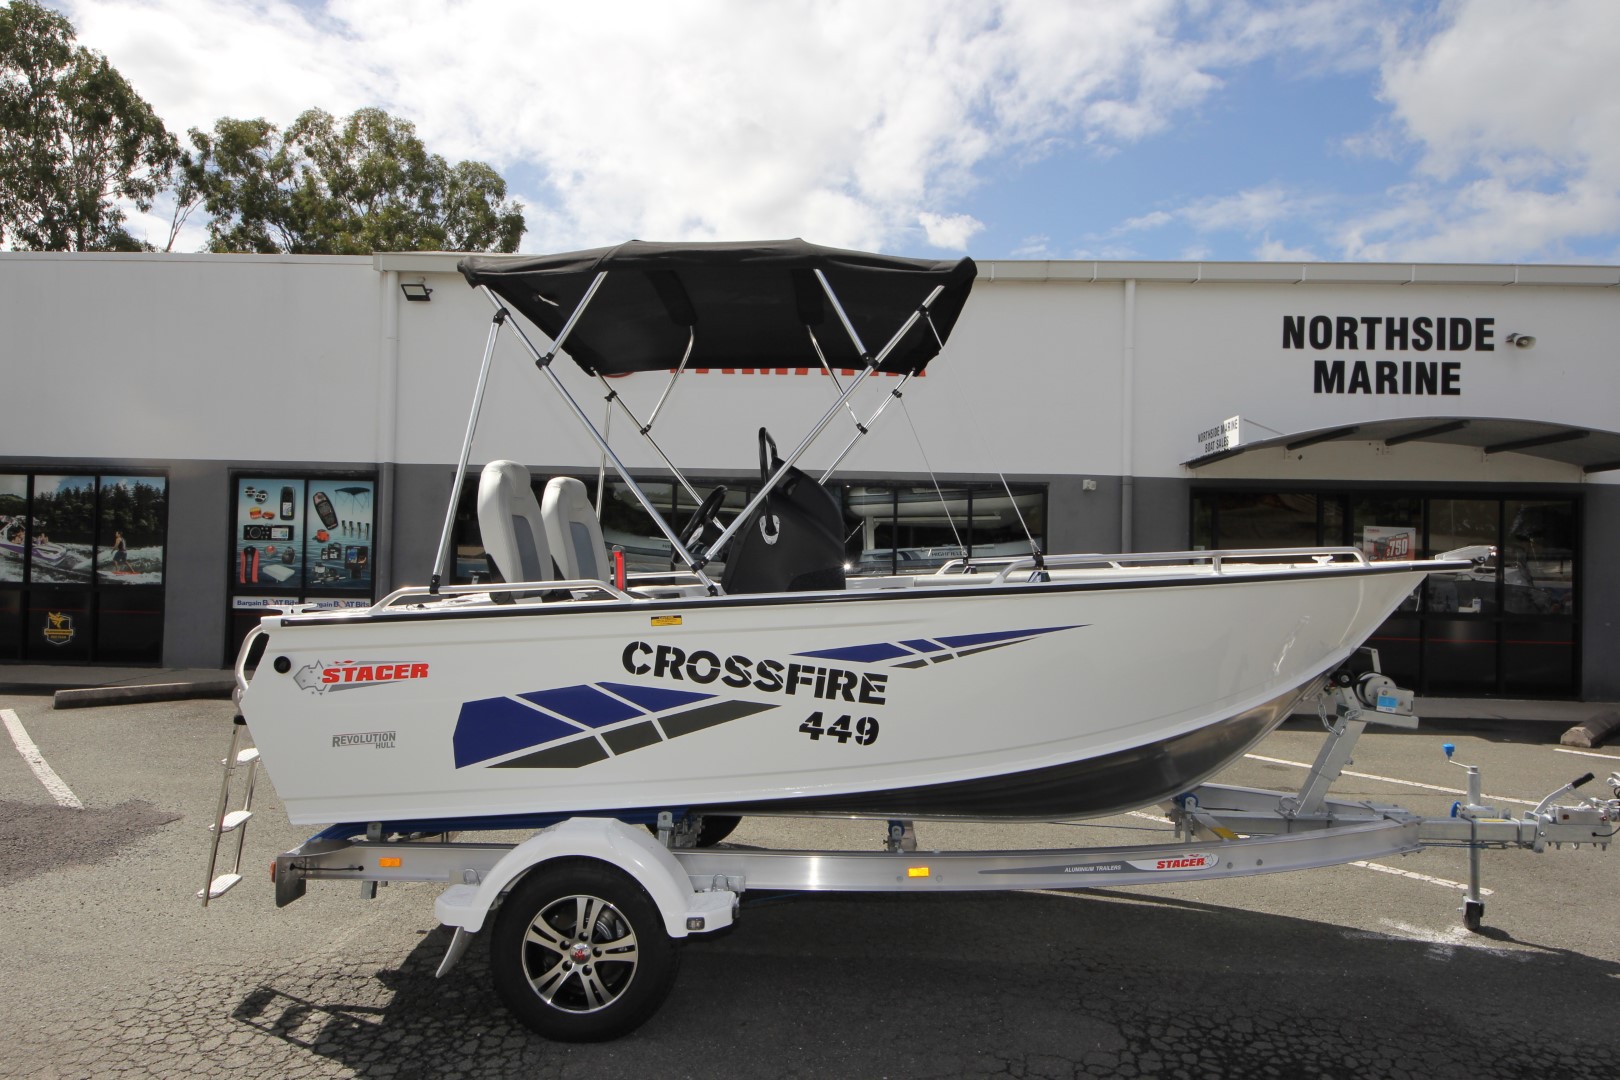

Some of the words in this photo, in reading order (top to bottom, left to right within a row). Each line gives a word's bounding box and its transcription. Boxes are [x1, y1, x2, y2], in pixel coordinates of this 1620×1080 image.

[1282, 315, 1495, 351] NORTHSIDE
[1313, 360, 1461, 395] MARINE
[1197, 425, 1220, 443] NORTHSIDE
[1220, 418, 1238, 435] MARINE
[1205, 440, 1216, 453] BOAT
[1216, 435, 1229, 449] SALES
[321, 663, 429, 684] STACER
[798, 711, 880, 746] 449
[332, 732, 396, 748] REVOLUTION
[375, 741, 396, 749] HULL
[1096, 864, 1121, 872] TRAILERS
[1156, 857, 1206, 869] STACER
